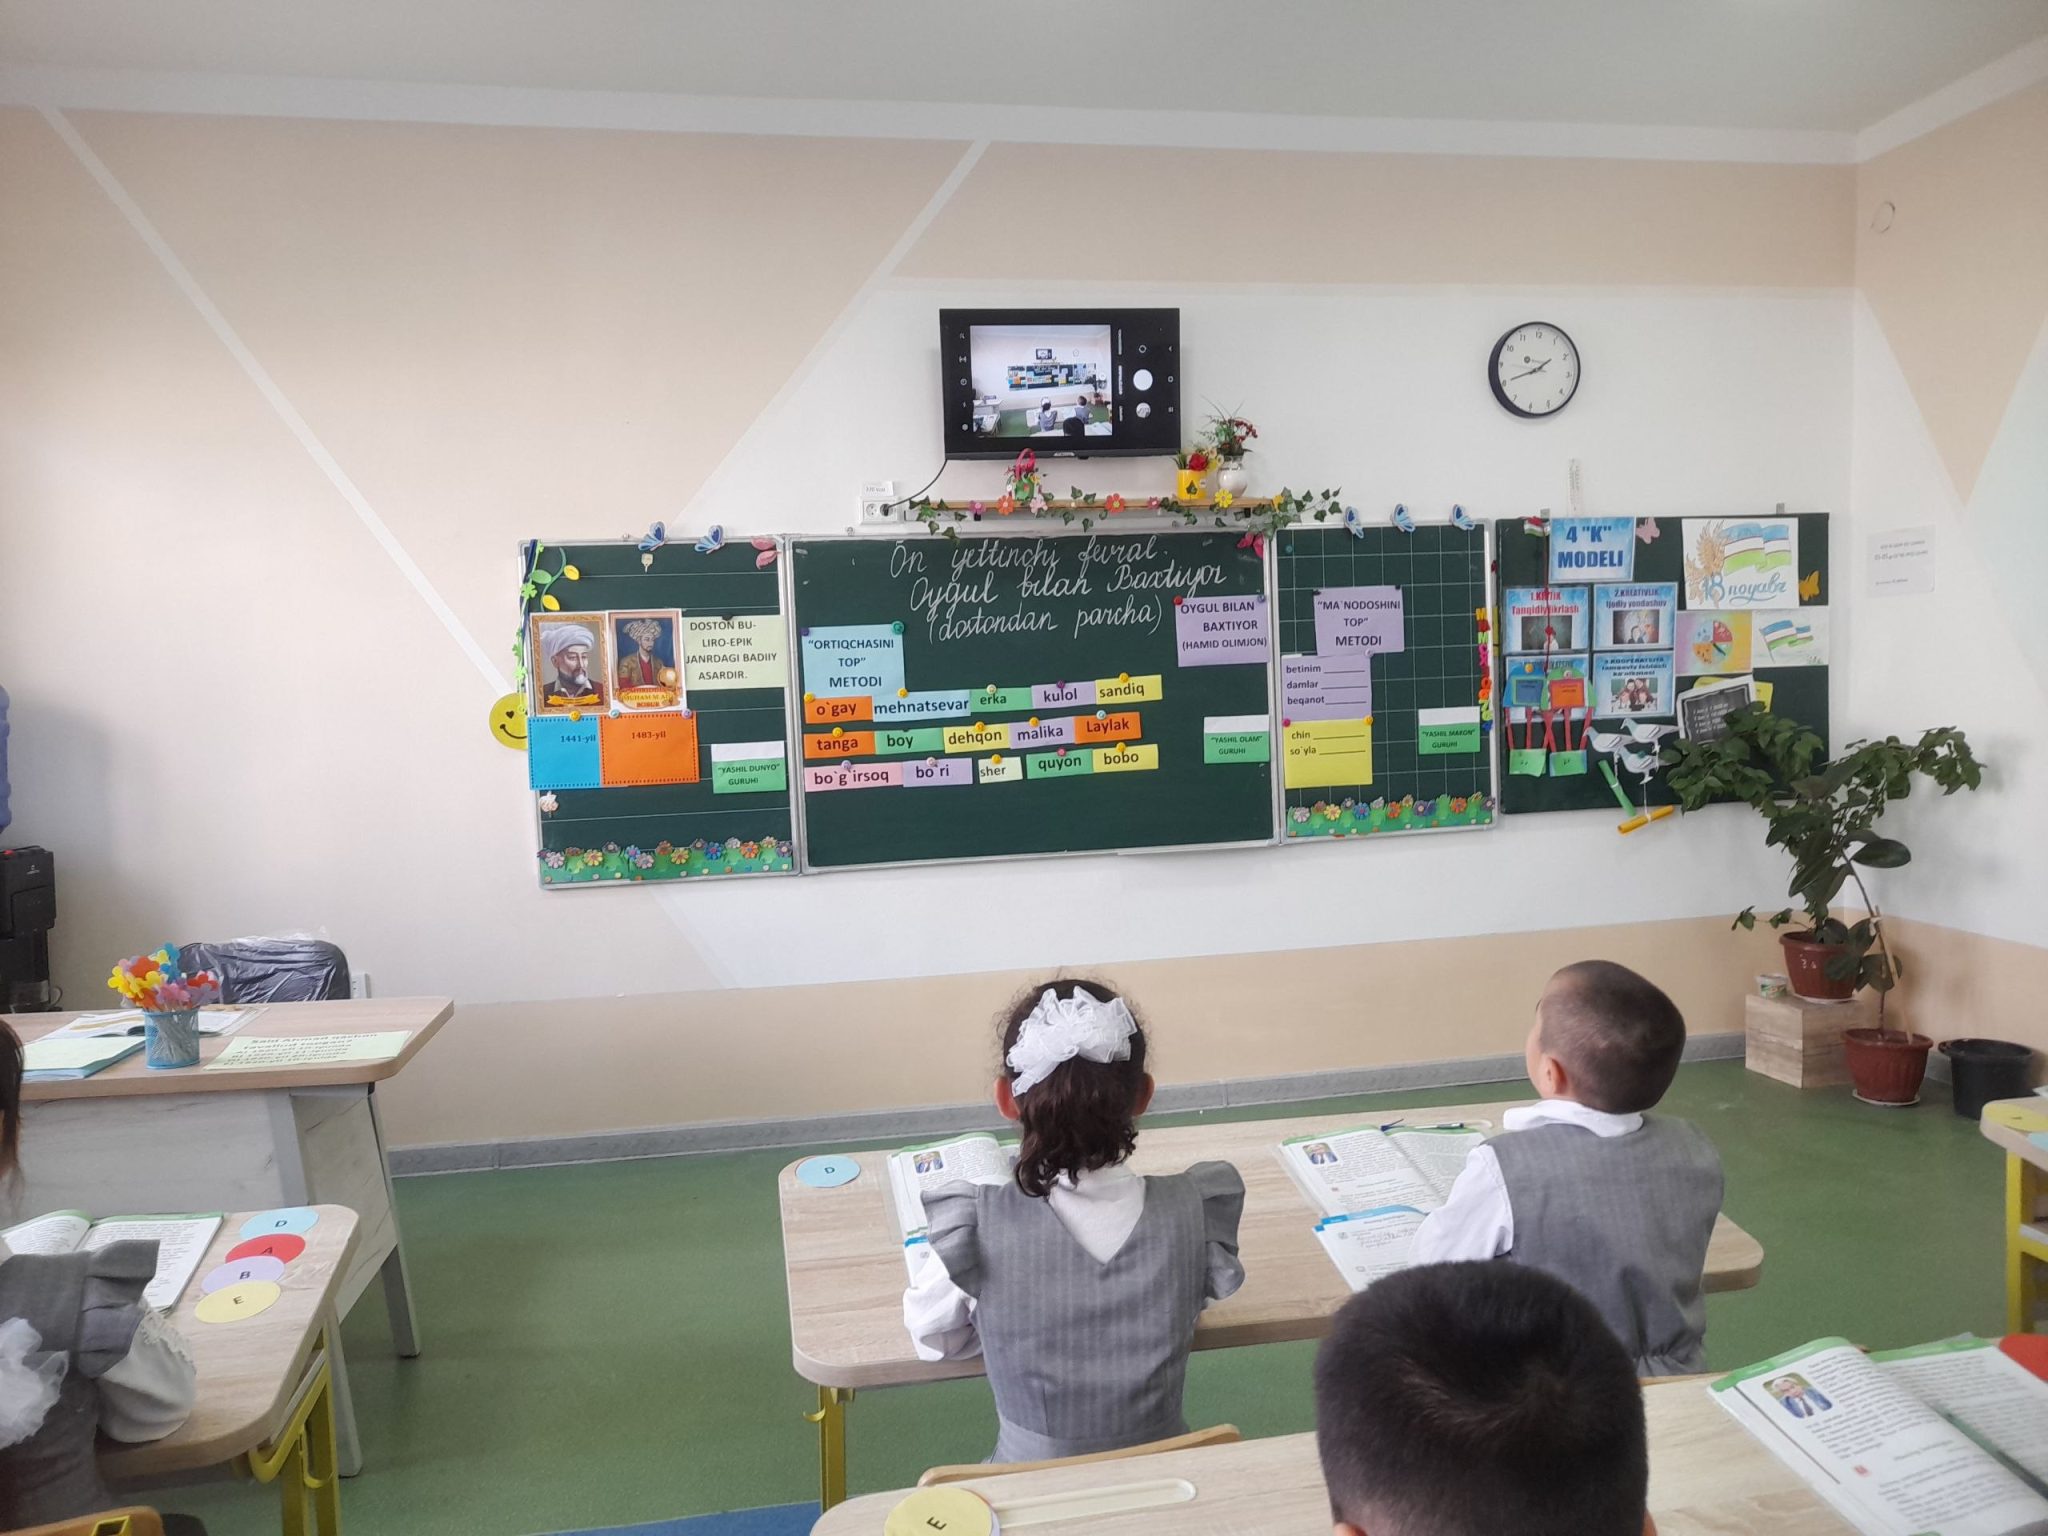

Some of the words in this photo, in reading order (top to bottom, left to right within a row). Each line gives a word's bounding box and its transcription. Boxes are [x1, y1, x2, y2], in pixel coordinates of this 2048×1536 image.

[1566, 526, 1577, 543] 4
[1582, 525, 1612, 543] "K"
[1557, 550, 1624, 568] MODELI
[910, 570, 999, 623] Oygul
[1106, 559, 1228, 598] Baxtiyor
[1700, 571, 1725, 601] 18
[1180, 603, 1220, 614] OYGUL
[1222, 601, 1255, 612] BILAN
[929, 600, 1059, 645] (dostondan
[1074, 593, 1163, 640] parcha)
[690, 620, 735, 631] DOSTON
[738, 620, 757, 630] BU-
[1203, 620, 1258, 632] BAXTIYOR
[702, 637, 753, 648] LIRO-EPIK
[1182, 639, 1219, 651] (HAMID
[1222, 636, 1268, 649] OLIMJON)
[1335, 635, 1382, 646] METODI
[686, 653, 740, 664] JANRDAGI
[743, 652, 777, 662] BADIIY
[1286, 664, 1322, 674] betinim
[698, 670, 748, 680] ASARDIR.
[829, 676, 882, 688] METODI
[1286, 680, 1319, 689] damlar
[874, 700, 969, 714] mehnatsevar
[980, 693, 1007, 705] erka
[1043, 688, 1078, 703] kulol
[1099, 682, 1145, 699] sandiq
[1287, 695, 1325, 706] beqanot
[560, 735, 596, 744] 1441-yil
[631, 730, 666, 740] 1483-yil
[817, 737, 859, 752] tanga
[887, 734, 914, 748] boy
[948, 729, 1002, 745] dehqon
[1017, 726, 1064, 741] malika
[1086, 718, 1130, 734] Laylak
[1291, 731, 1311, 740] chin
[1218, 747, 1246, 755] GURUHI
[980, 765, 1006, 777] sher
[1038, 754, 1082, 771] quyon
[1103, 752, 1139, 765] bobo
[728, 777, 759, 786] GURUHI
[824, 1166, 835, 1174] D
[275, 1219, 288, 1228] D
[261, 1246, 273, 1255] A
[239, 1271, 251, 1280] B
[233, 1295, 244, 1305] E
[926, 1516, 946, 1531] E
